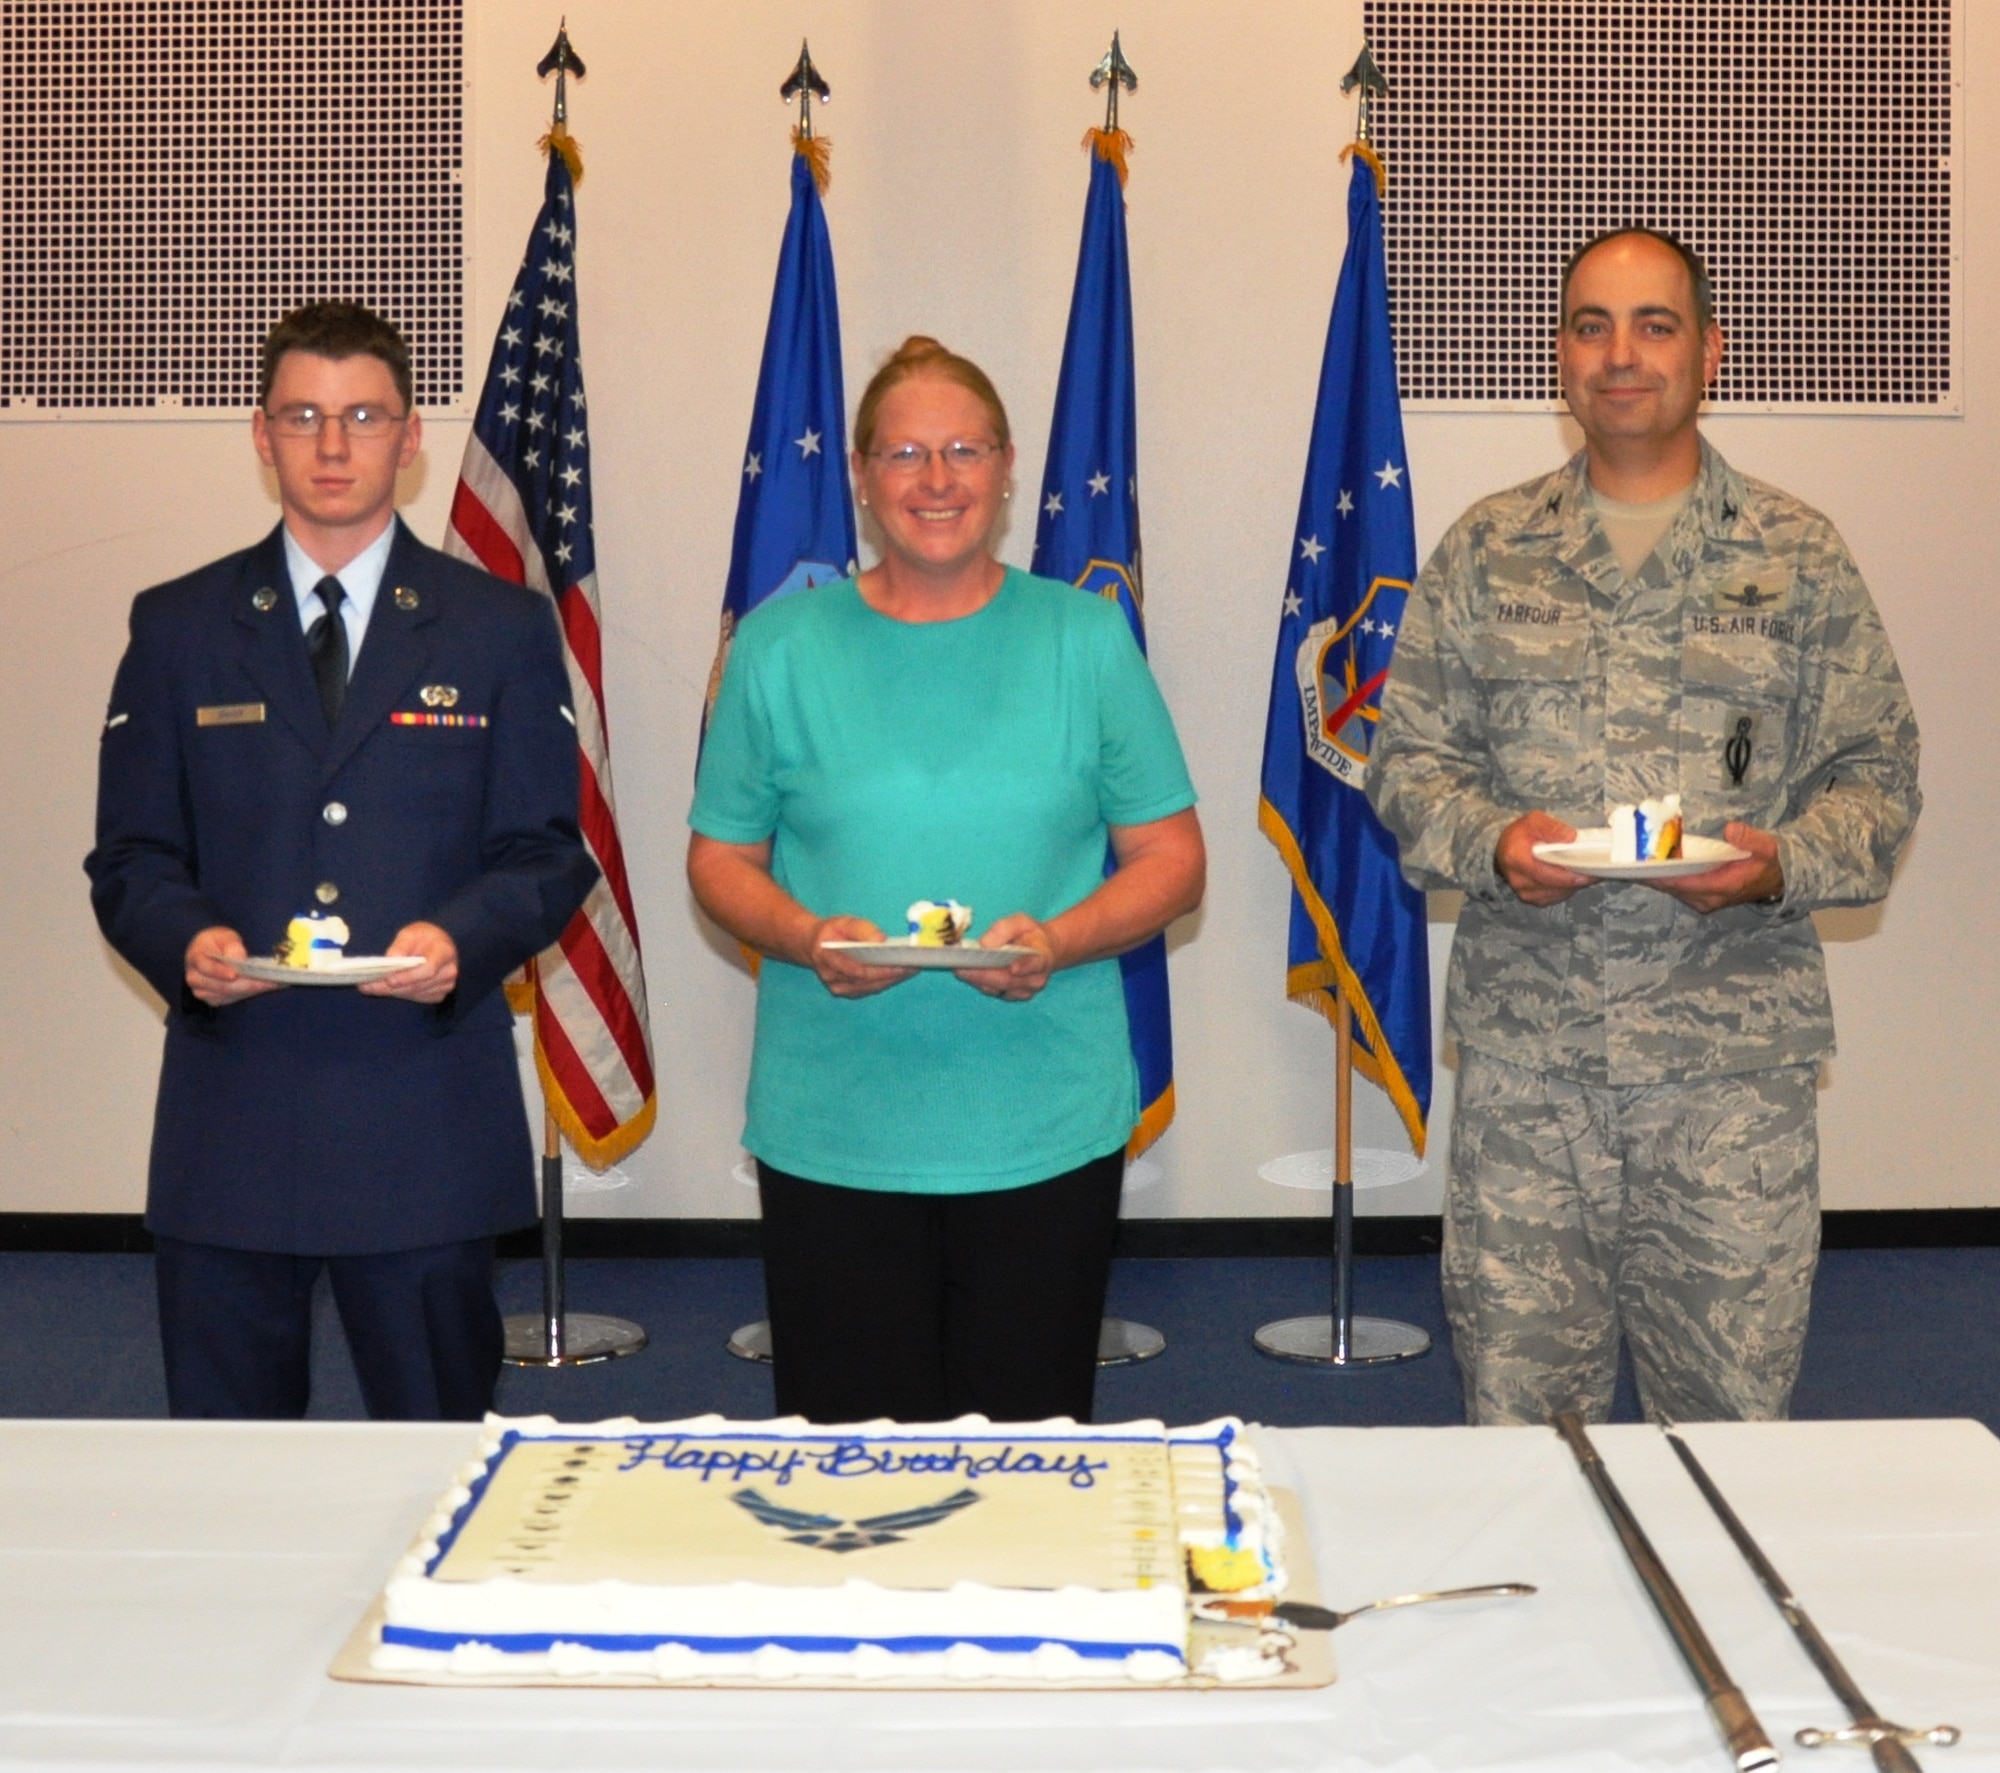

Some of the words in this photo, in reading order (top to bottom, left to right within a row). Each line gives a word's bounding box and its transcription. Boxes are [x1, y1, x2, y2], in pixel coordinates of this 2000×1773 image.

[1497, 604, 1561, 625] FARFOUR
[1694, 616, 1725, 634] U.S.
[1730, 617, 1755, 635] AIR
[618, 1440, 804, 1485] Happy
[805, 1444, 1108, 1488] Birthday
